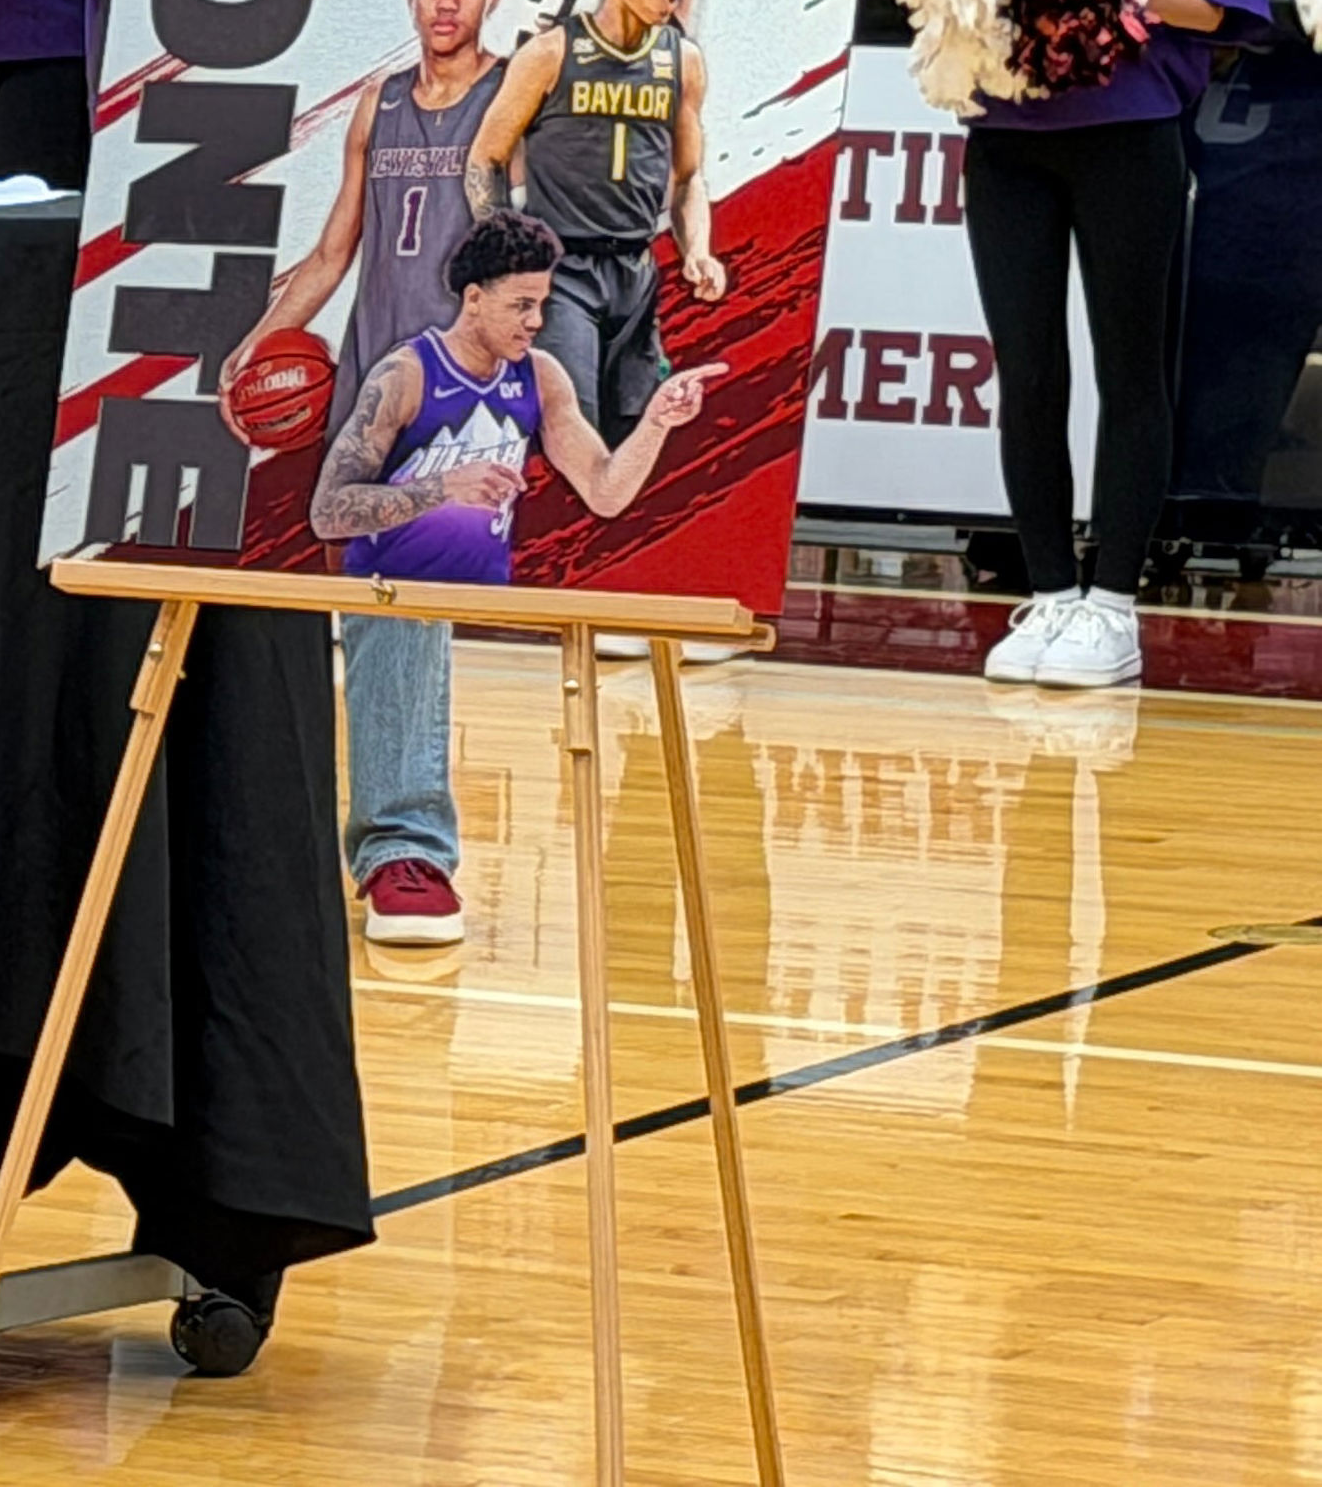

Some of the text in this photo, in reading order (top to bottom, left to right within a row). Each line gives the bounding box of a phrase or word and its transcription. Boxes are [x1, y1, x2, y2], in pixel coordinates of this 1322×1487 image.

[572, 80, 672, 121] BAYLOR
[612, 121, 628, 182] 1
[396, 185, 429, 257] 1
